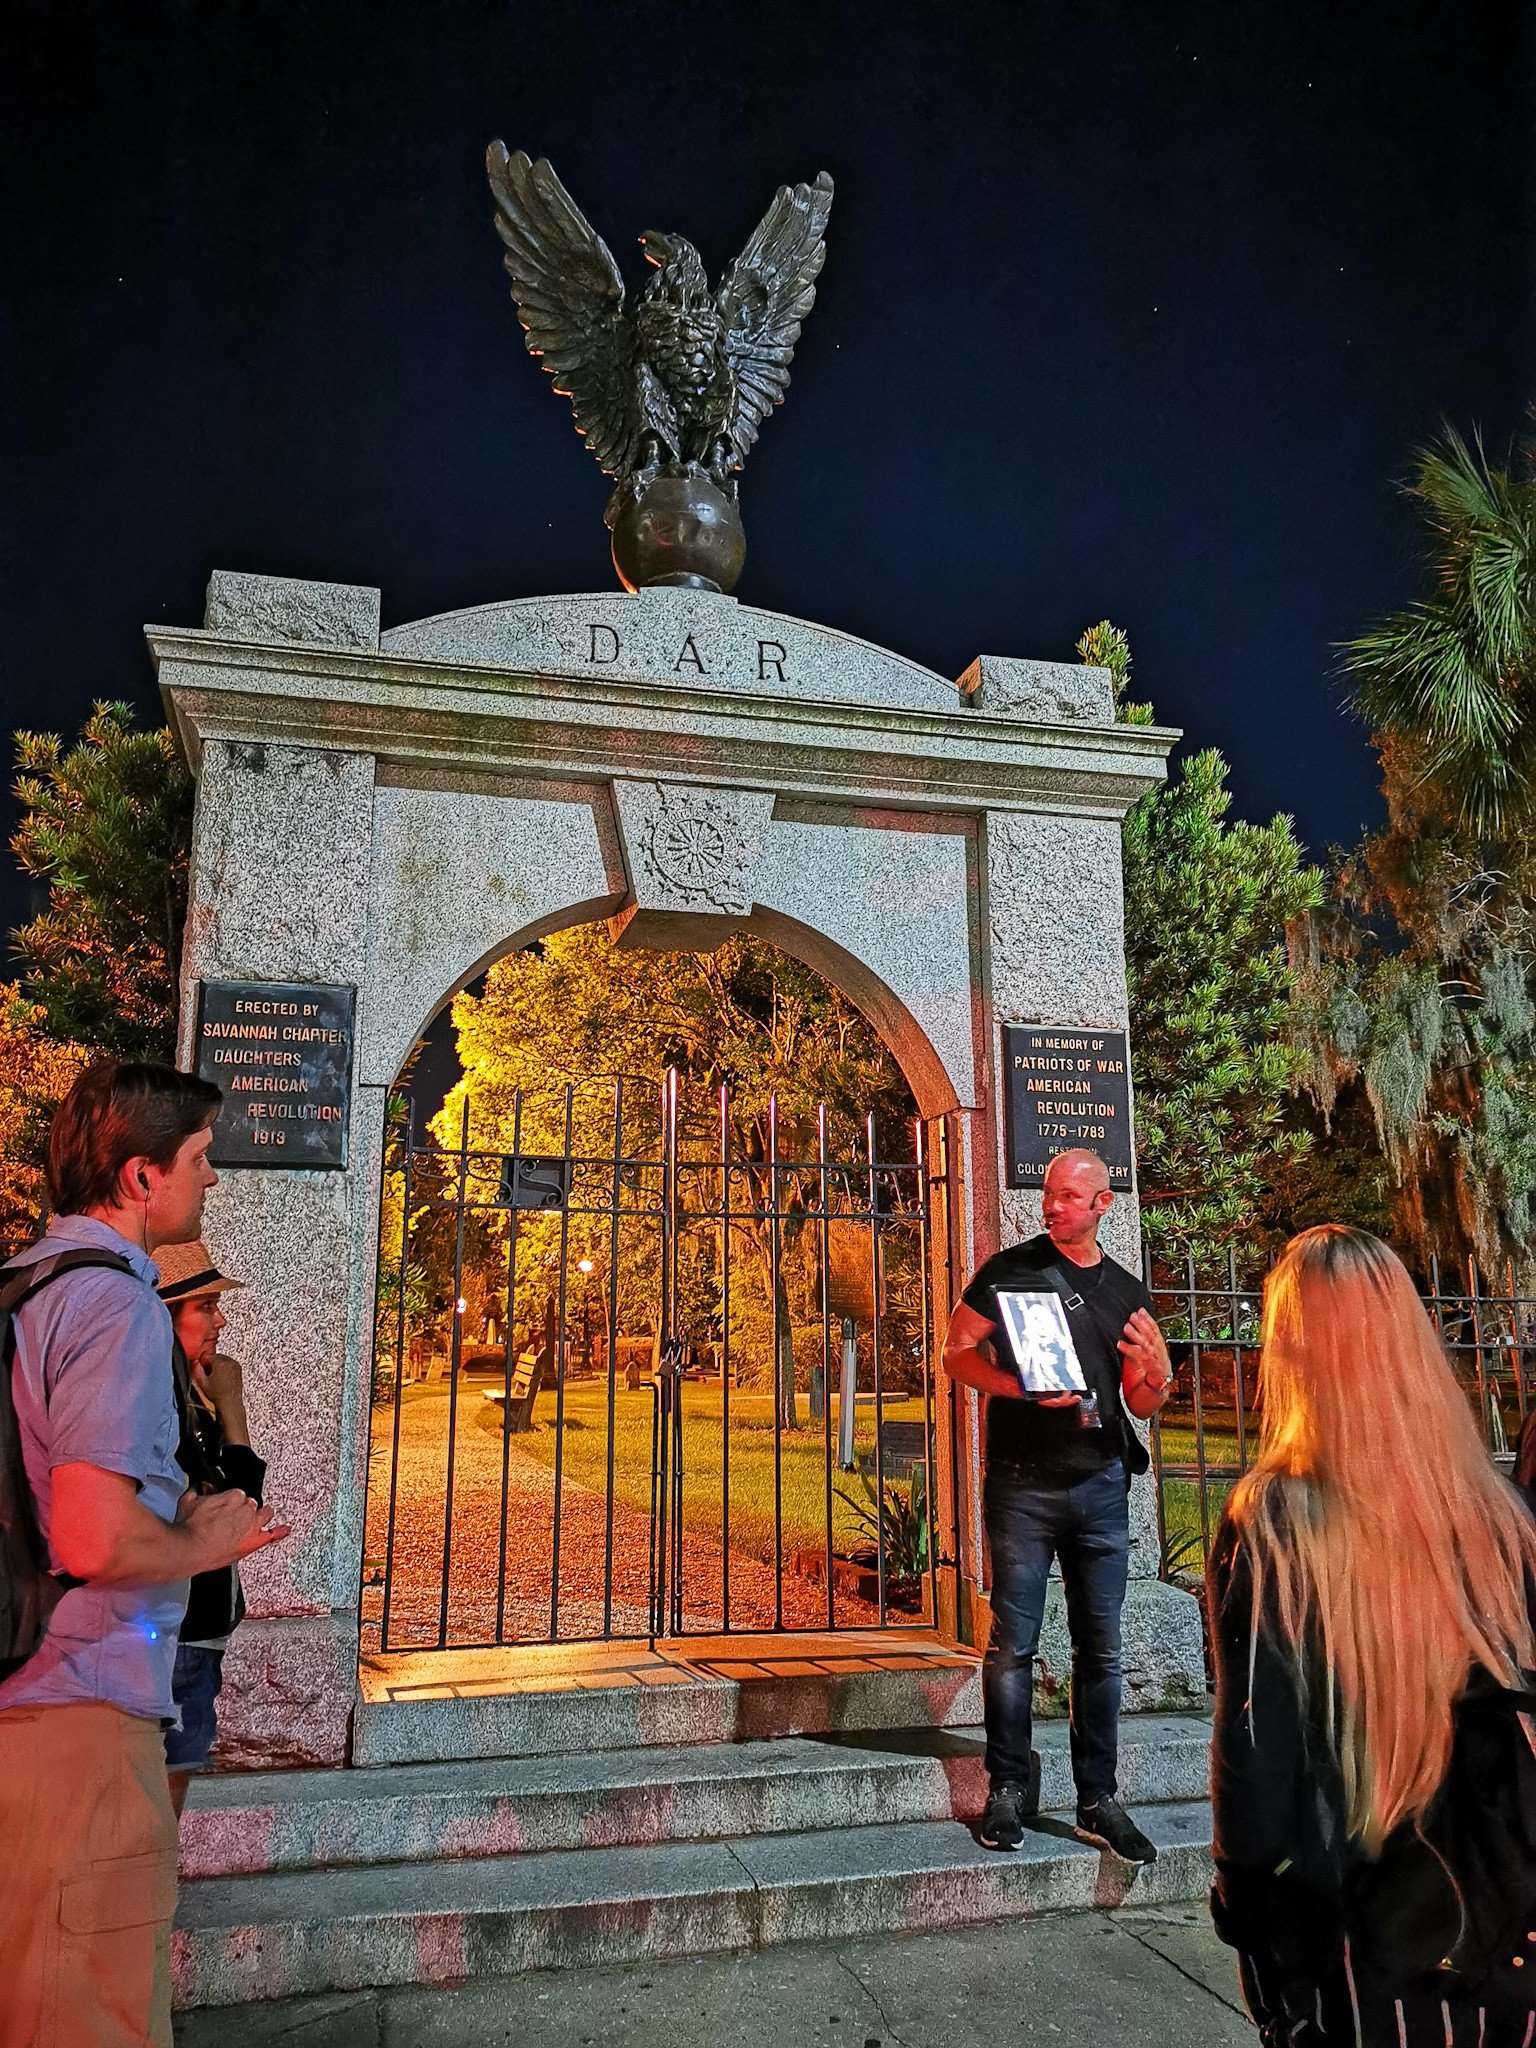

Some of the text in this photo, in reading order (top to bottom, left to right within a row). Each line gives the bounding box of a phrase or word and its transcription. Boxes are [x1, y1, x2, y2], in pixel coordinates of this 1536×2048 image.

[585, 624, 787, 682] D A R
[235, 1000, 319, 1016] ERECTED BY
[203, 1022, 347, 1043] SAVANNAH CHAPTER
[1031, 1037, 1105, 1051] IN MEMORY OF
[214, 1049, 302, 1066] DAUGHTERS
[1014, 1055, 1124, 1073] PATRIOTS OF WAR
[231, 1075, 309, 1092] AMERICAN
[1026, 1078, 1091, 1094] AMERICAN
[247, 1103, 342, 1120] REVOLUTION
[1037, 1101, 1115, 1117] REVOLUTION
[253, 1131, 286, 1146] 1913
[1037, 1123, 1105, 1139] 1775-1783
